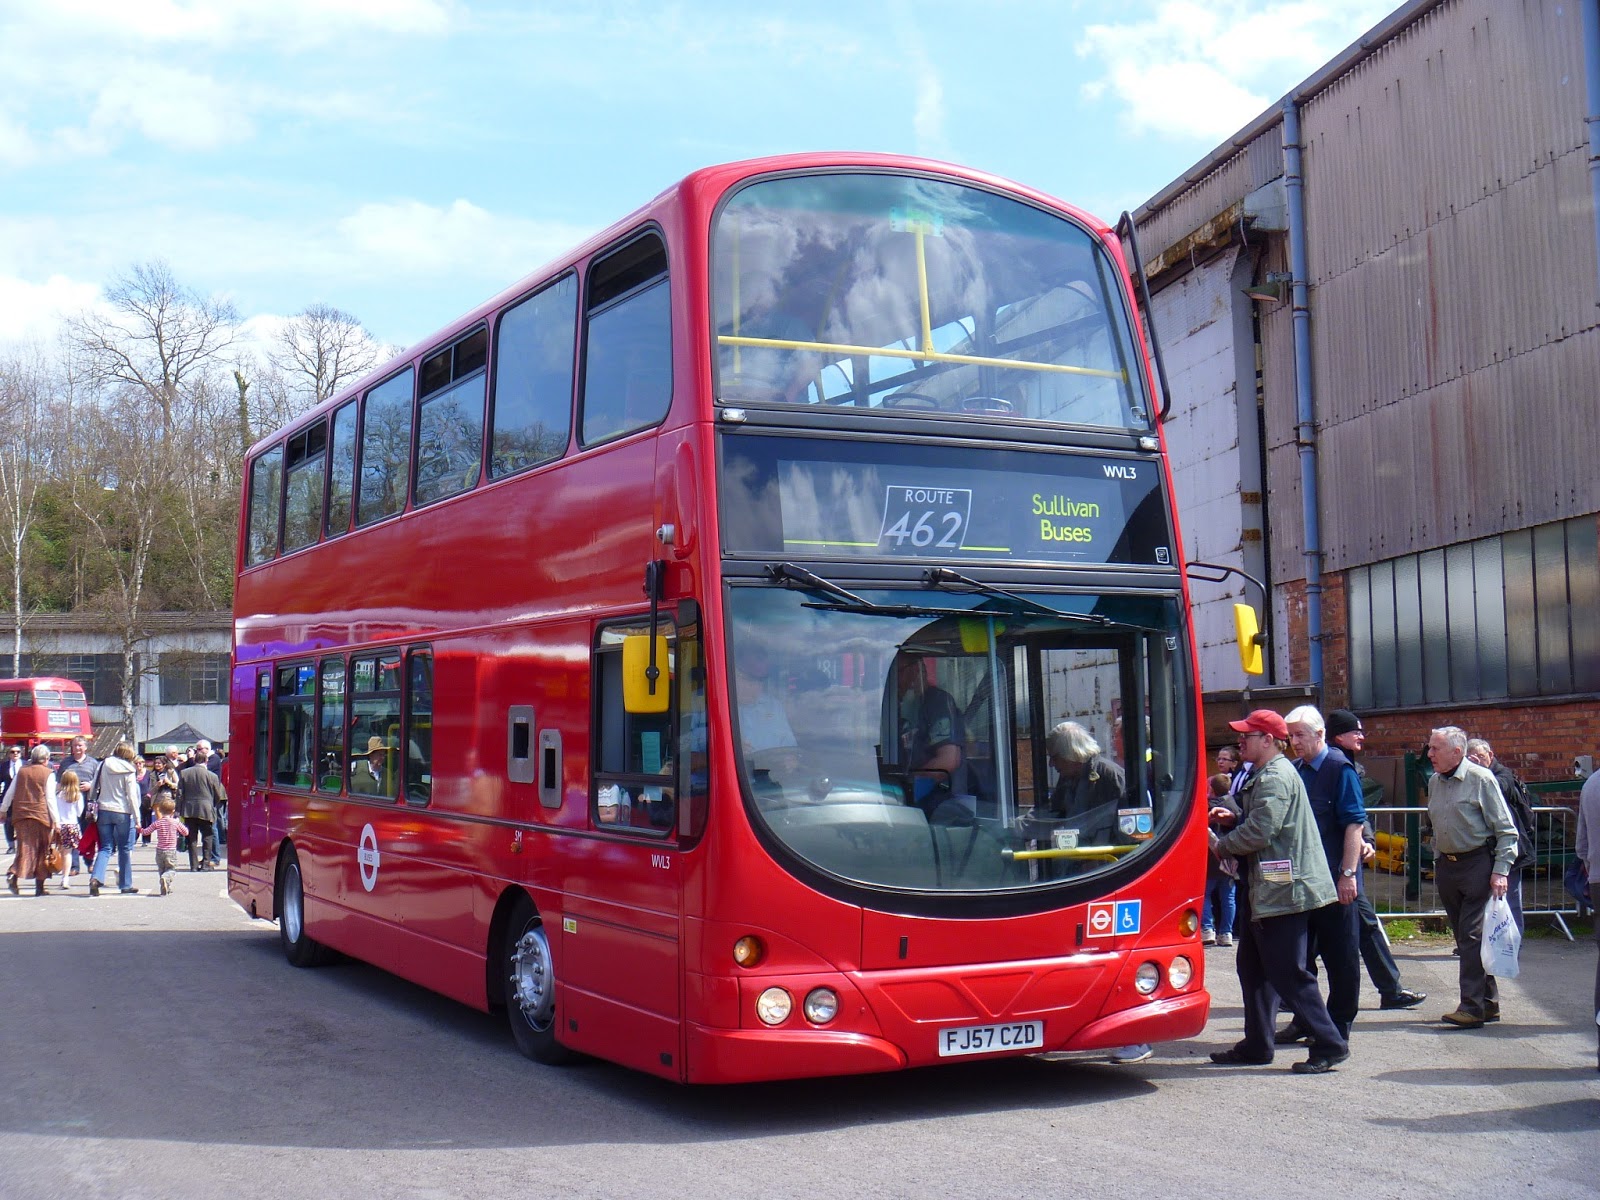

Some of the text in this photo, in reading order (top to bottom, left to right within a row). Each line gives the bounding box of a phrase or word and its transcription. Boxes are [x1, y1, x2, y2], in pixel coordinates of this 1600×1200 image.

[1103, 465, 1137, 479] WVL3
[905, 490, 953, 504] ROUTE
[1032, 493, 1099, 517] Sullivan
[884, 511, 963, 548] 462
[1040, 519, 1092, 542] Buses
[515, 830, 522, 842] SM
[651, 854, 670, 869] WVL3
[947, 1025, 1035, 1051] FJ57 CZD
